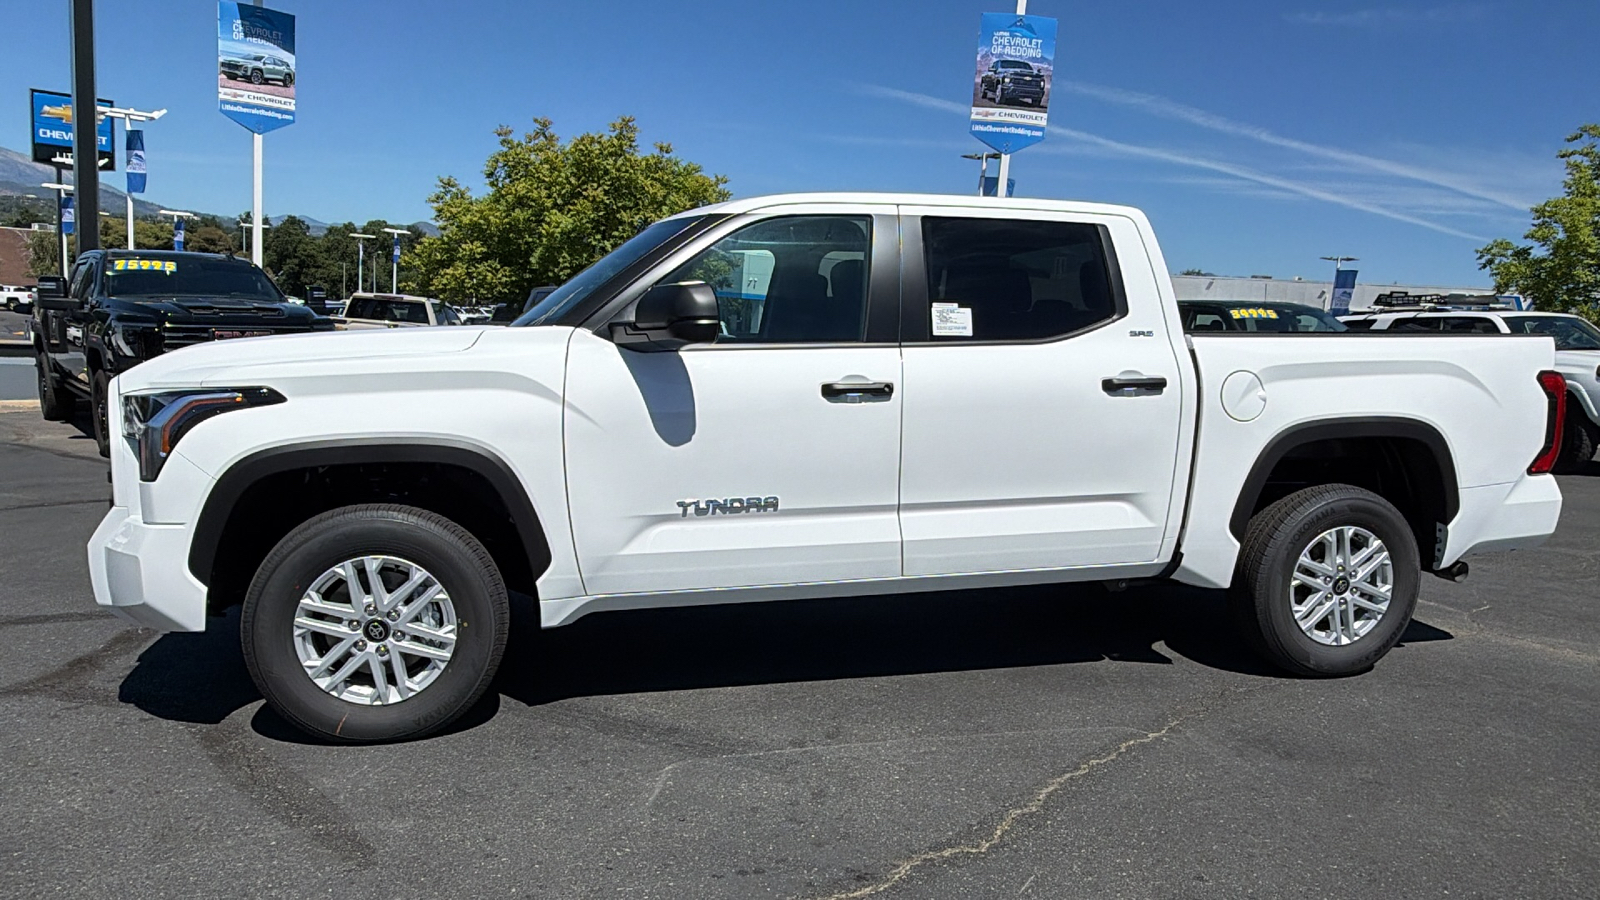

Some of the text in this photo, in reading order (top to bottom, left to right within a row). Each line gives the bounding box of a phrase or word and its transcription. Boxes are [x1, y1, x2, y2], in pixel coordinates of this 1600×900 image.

[233, 23, 283, 40] CHEVROLET
[233, 32, 245, 40] OF
[992, 36, 1043, 48] CHEVROLET
[991, 45, 1042, 58] OF REDDING
[247, 94, 293, 107] CHEVROLET
[998, 111, 1044, 121] CHEVROLET
[676, 496, 779, 517] TUNDRA
[1289, 507, 1337, 546] YOKOHAMA
